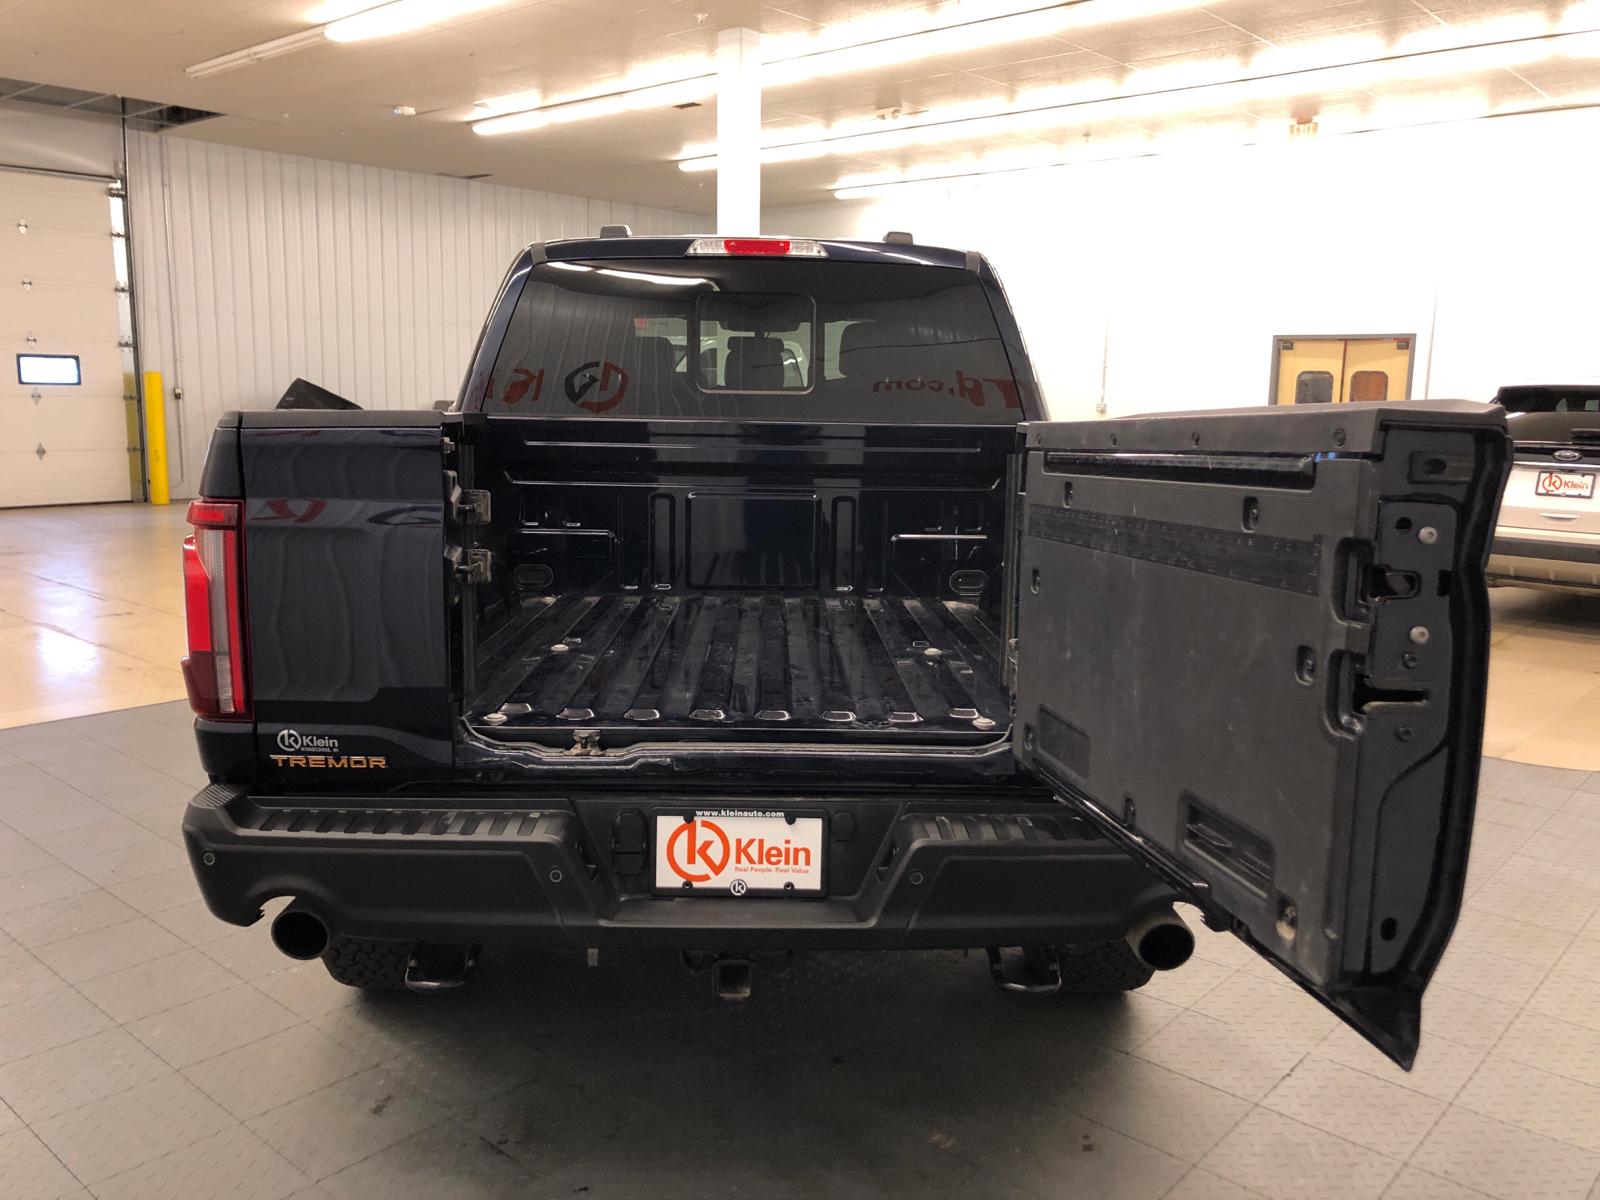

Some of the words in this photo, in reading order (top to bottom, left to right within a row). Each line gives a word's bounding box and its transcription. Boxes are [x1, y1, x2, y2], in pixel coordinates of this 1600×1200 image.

[1563, 480, 1589, 490] Klein
[302, 735, 339, 748] Klein
[269, 754, 388, 769] TREMOR
[695, 809, 785, 818] www.kleinauto.com
[735, 838, 811, 866] Klein
[750, 866, 774, 874] People.
